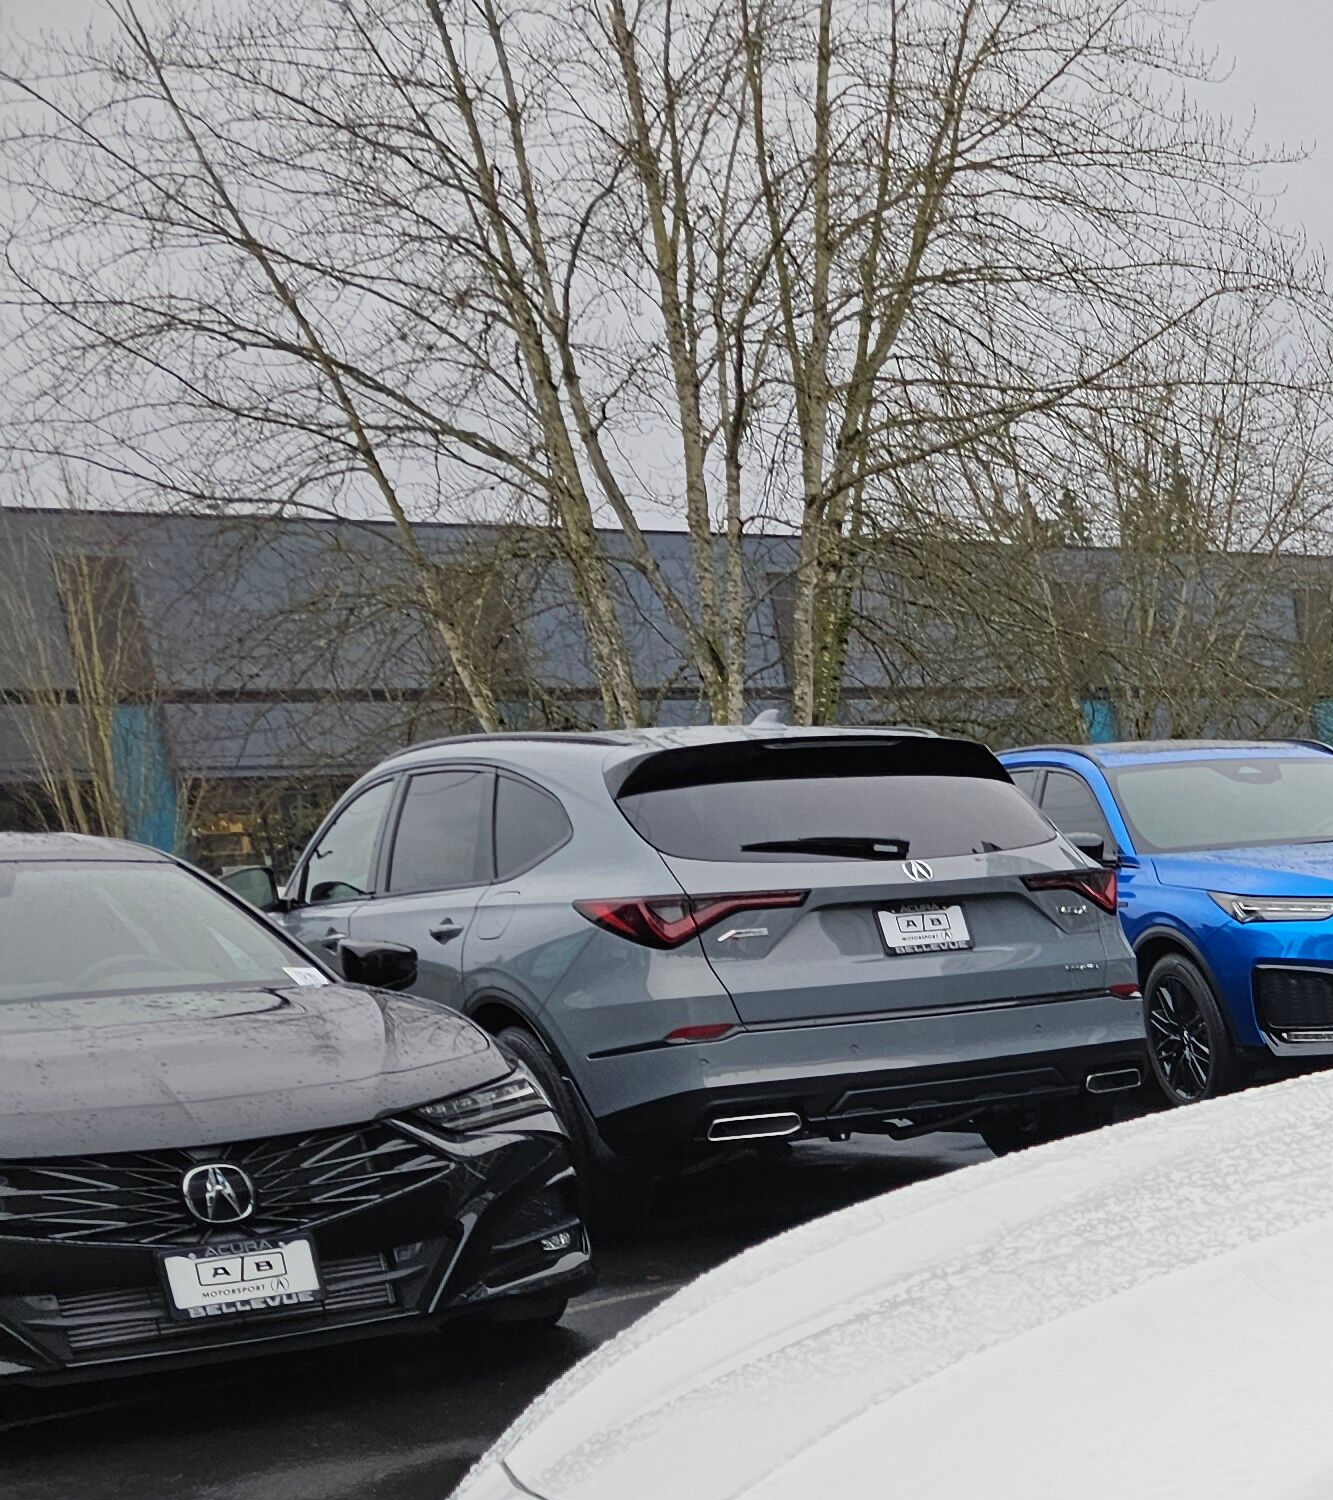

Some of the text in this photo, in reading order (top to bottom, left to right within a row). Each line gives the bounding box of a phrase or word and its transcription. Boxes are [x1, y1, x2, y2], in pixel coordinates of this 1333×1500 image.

[895, 941, 968, 954] BELLEVUE
[205, 1239, 273, 1258] ACURA
[212, 1260, 273, 1278] A B
[202, 1284, 266, 1299] MOTORSPORT
[187, 1291, 315, 1319] BELLEVUE
